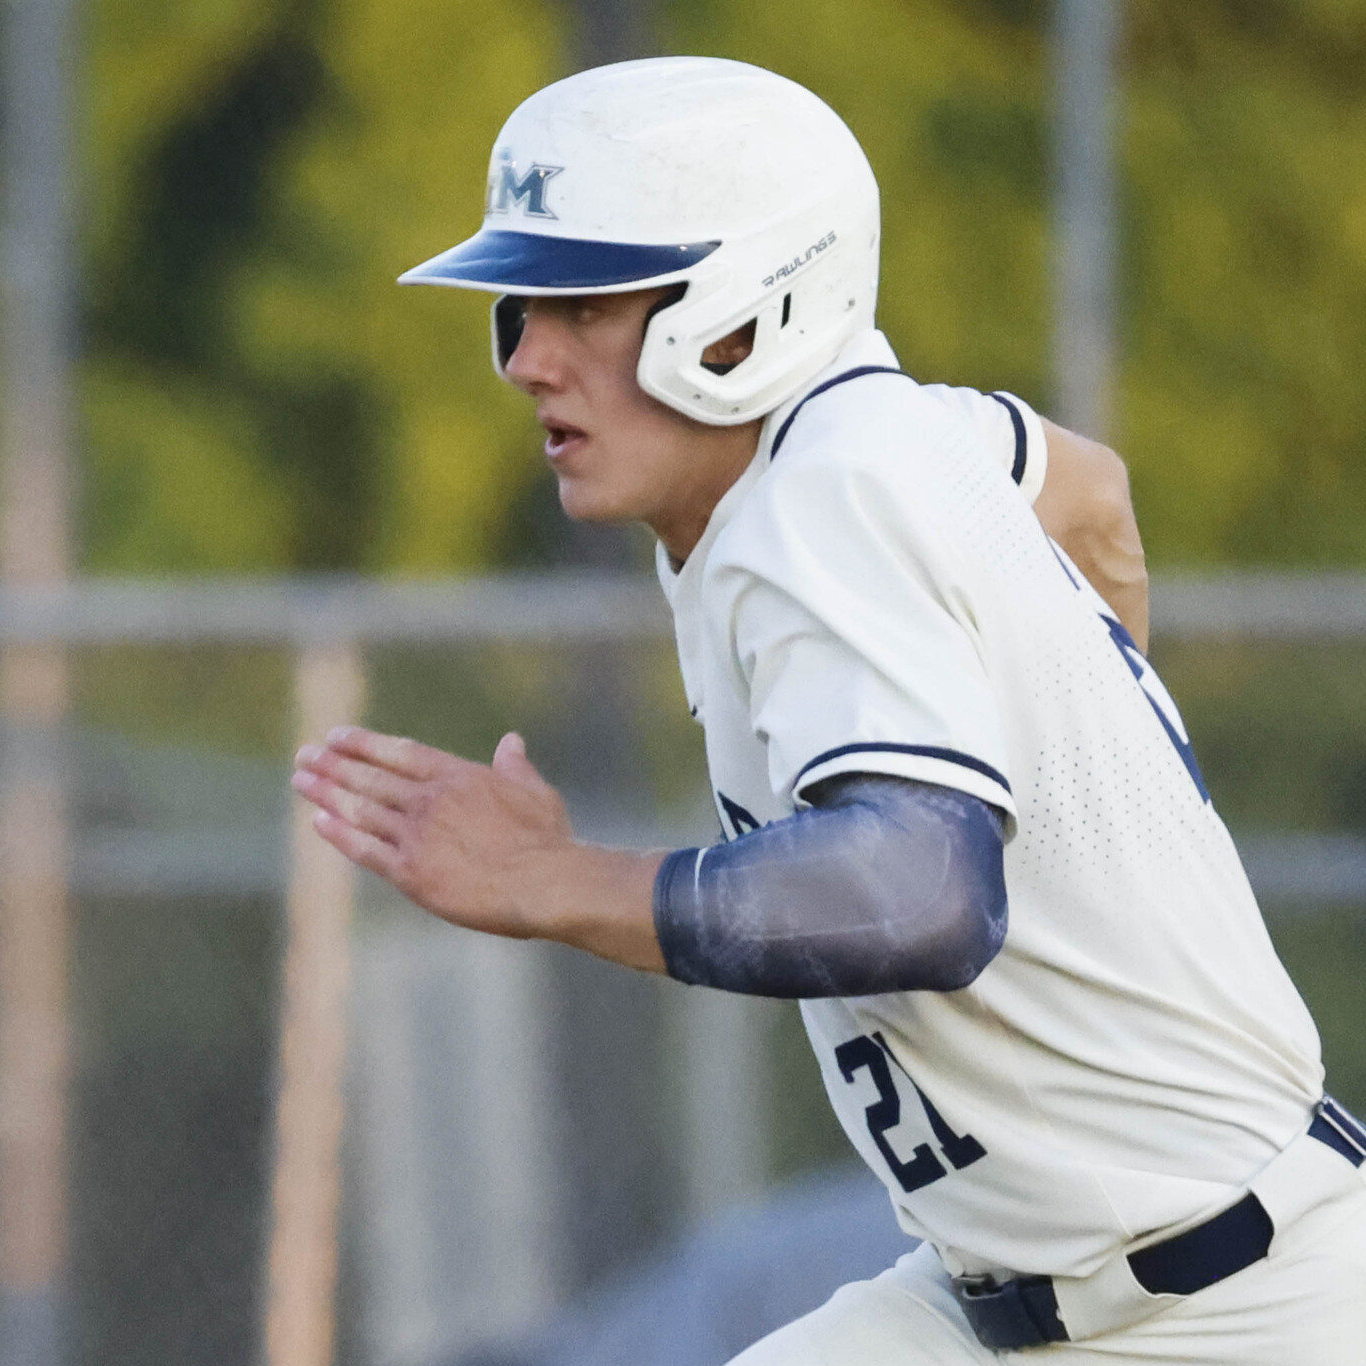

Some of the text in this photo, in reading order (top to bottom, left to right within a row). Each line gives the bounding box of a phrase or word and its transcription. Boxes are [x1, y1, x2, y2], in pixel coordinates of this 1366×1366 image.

[486, 163, 565, 220] M
[761, 230, 837, 287] RAWLINGS
[835, 1031, 988, 1193] 21
